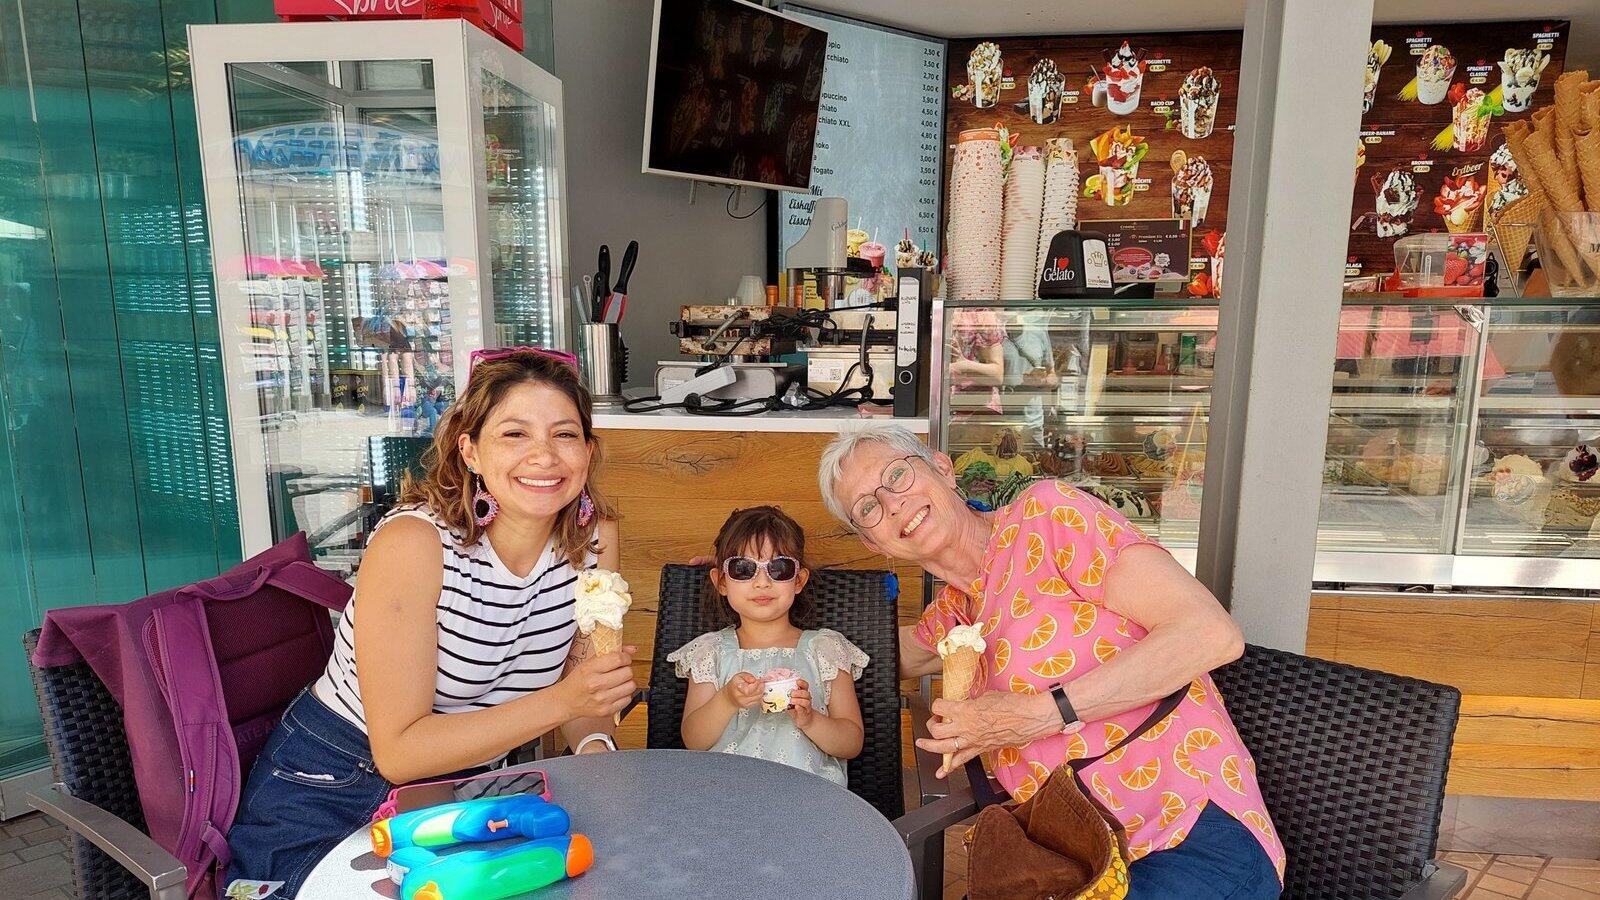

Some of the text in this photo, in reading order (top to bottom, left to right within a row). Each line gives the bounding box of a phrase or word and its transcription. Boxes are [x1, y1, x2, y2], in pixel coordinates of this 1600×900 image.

[827, 54, 849, 64] cchiato
[818, 116, 838, 126] chiato
[838, 119, 851, 127] XXL
[813, 166, 834, 175] fogato
[1451, 162, 1485, 177] Erdbeer
[810, 184, 824, 197] Mix
[789, 198, 817, 214] Eiskaff
[789, 213, 812, 226] Eissch
[1053, 257, 1058, 272] I
[1043, 266, 1075, 282] Gelato
